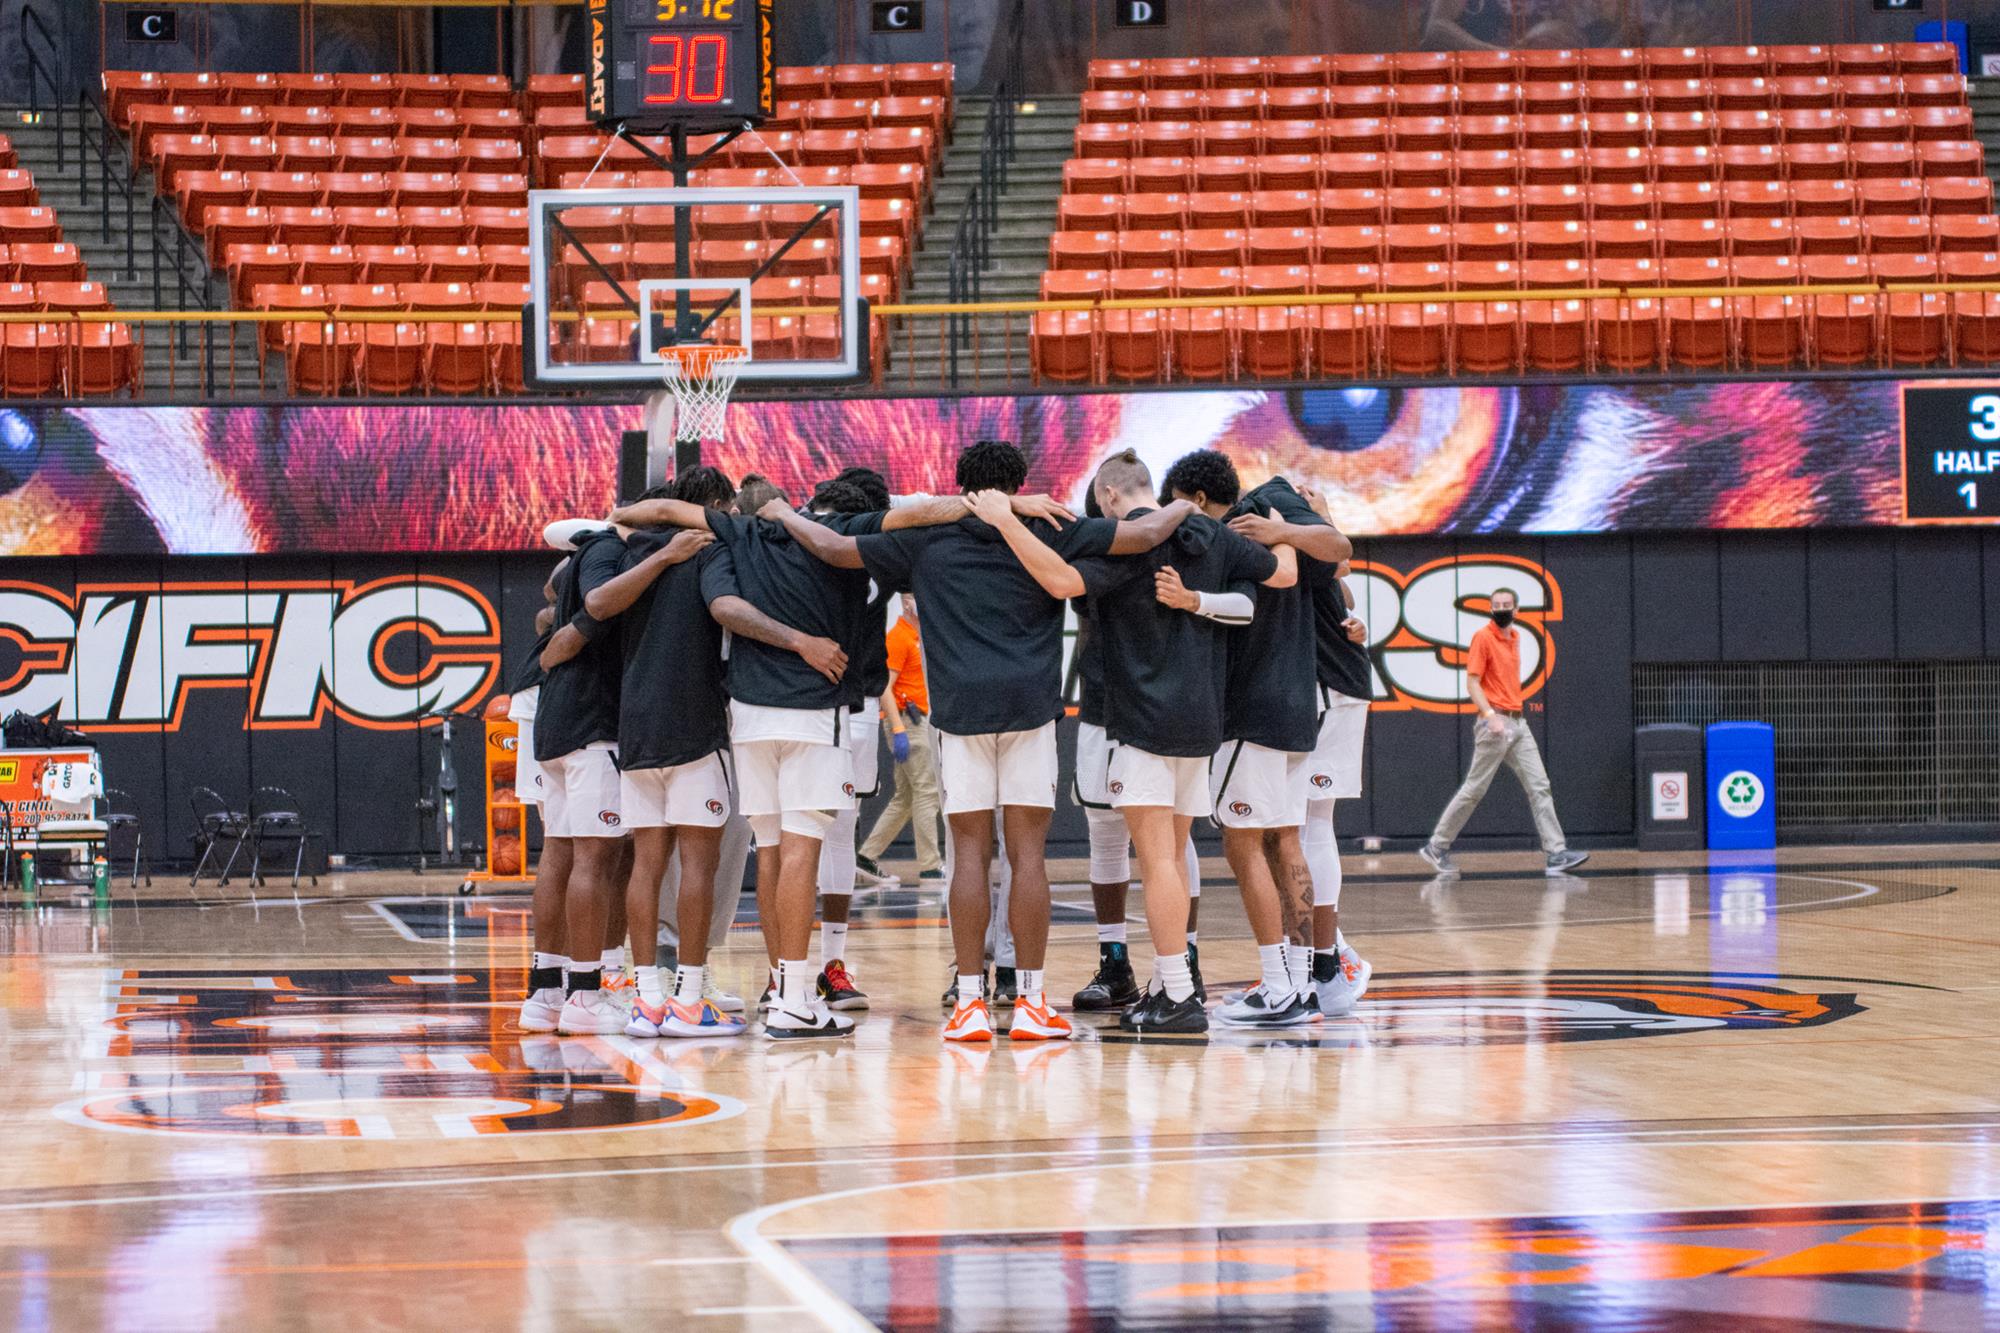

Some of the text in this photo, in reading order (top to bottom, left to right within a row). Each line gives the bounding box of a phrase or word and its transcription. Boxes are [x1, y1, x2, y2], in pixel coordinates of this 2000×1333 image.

[888, 6, 909, 27] C
[1131, 1, 1151, 22] D
[142, 15, 161, 37] C
[644, 34, 727, 103] 30
[1935, 450, 2000, 474] HALF
[1957, 481, 1977, 509] 1
